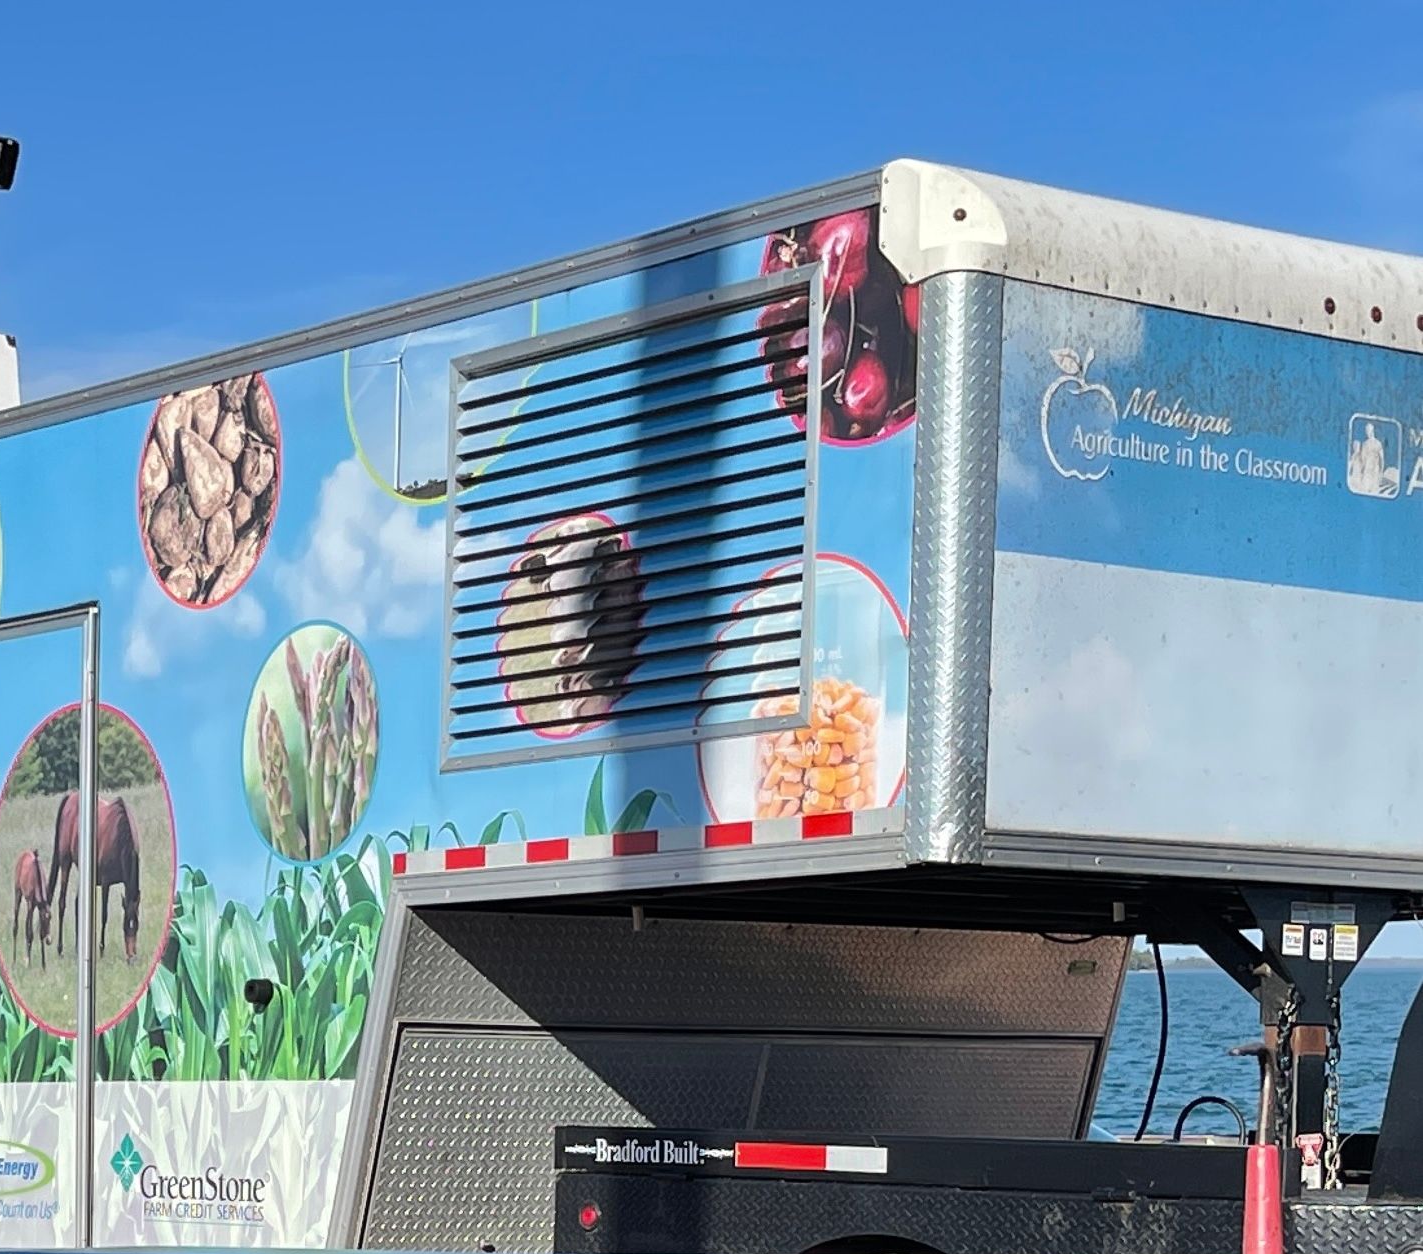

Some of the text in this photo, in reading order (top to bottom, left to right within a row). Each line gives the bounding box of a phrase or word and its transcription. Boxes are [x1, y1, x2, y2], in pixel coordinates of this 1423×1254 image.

[1123, 387, 1233, 441] Michigan
[1071, 424, 1327, 486] Agriculture in the Classroom
[595, 1138, 660, 1163] Bradford
[140, 1165, 265, 1203] GreenStone
[25, 1203, 38, 1217] on
[143, 1201, 265, 1221] FARM CREDIT SERVICES
